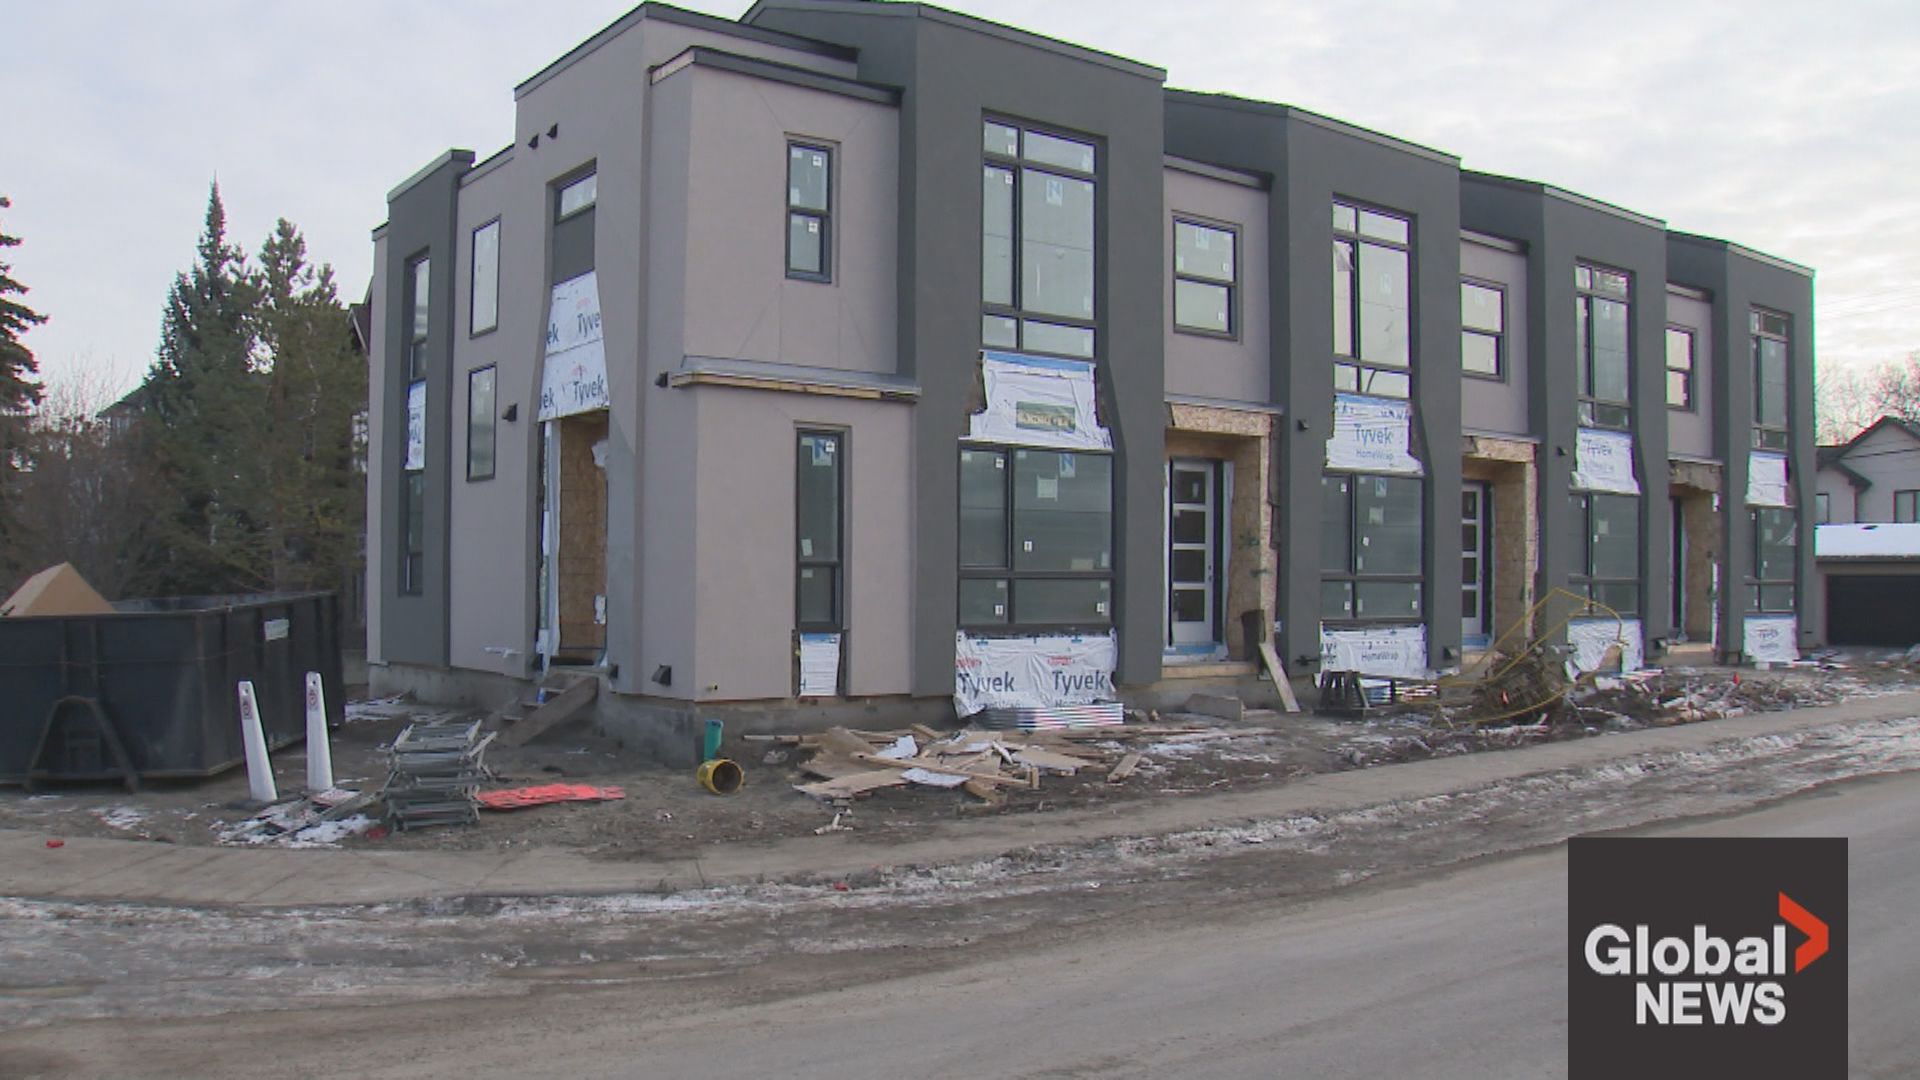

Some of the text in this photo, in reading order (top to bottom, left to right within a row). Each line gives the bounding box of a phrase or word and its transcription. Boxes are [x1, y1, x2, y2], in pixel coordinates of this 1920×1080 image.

[573, 374, 604, 406] Tyvek
[1354, 423, 1393, 448] Tyvek
[957, 670, 1106, 698] Tyvek Tyvek
